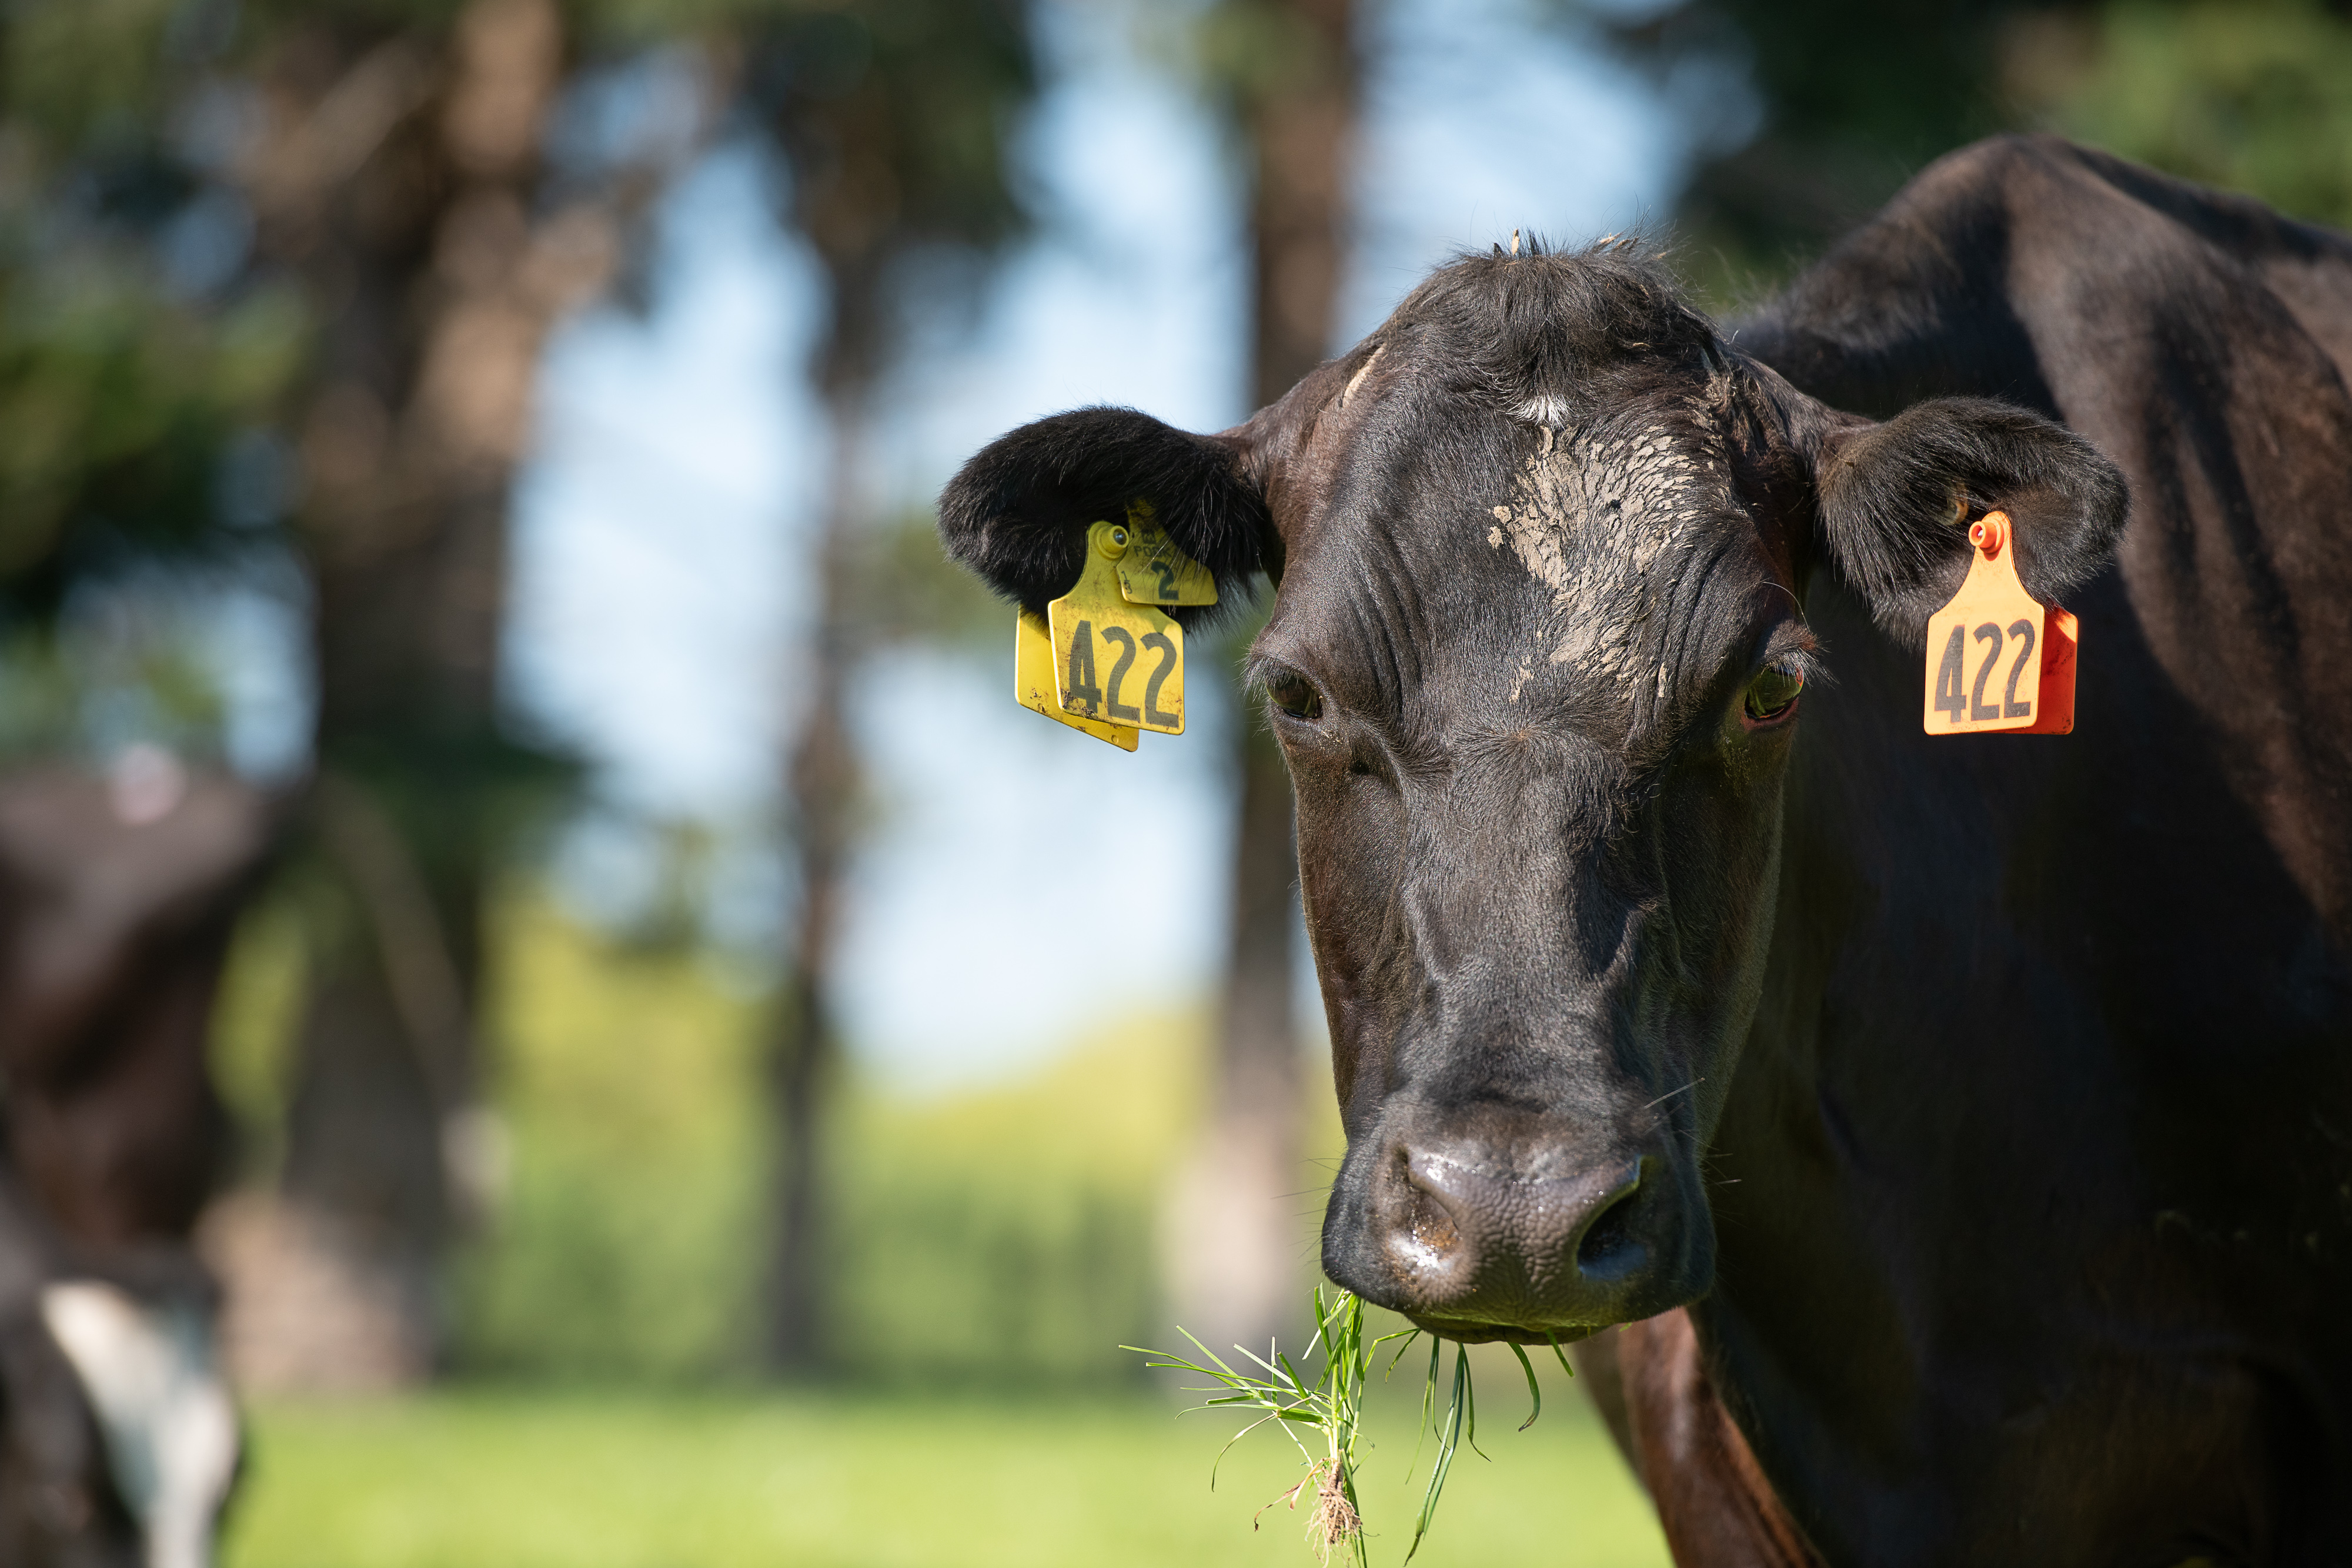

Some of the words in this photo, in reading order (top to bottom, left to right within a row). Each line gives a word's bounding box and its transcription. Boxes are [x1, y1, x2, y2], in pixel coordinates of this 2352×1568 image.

[1151, 561, 1179, 600] 2
[1069, 620, 1179, 728] 422
[1934, 618, 2035, 723] 422
